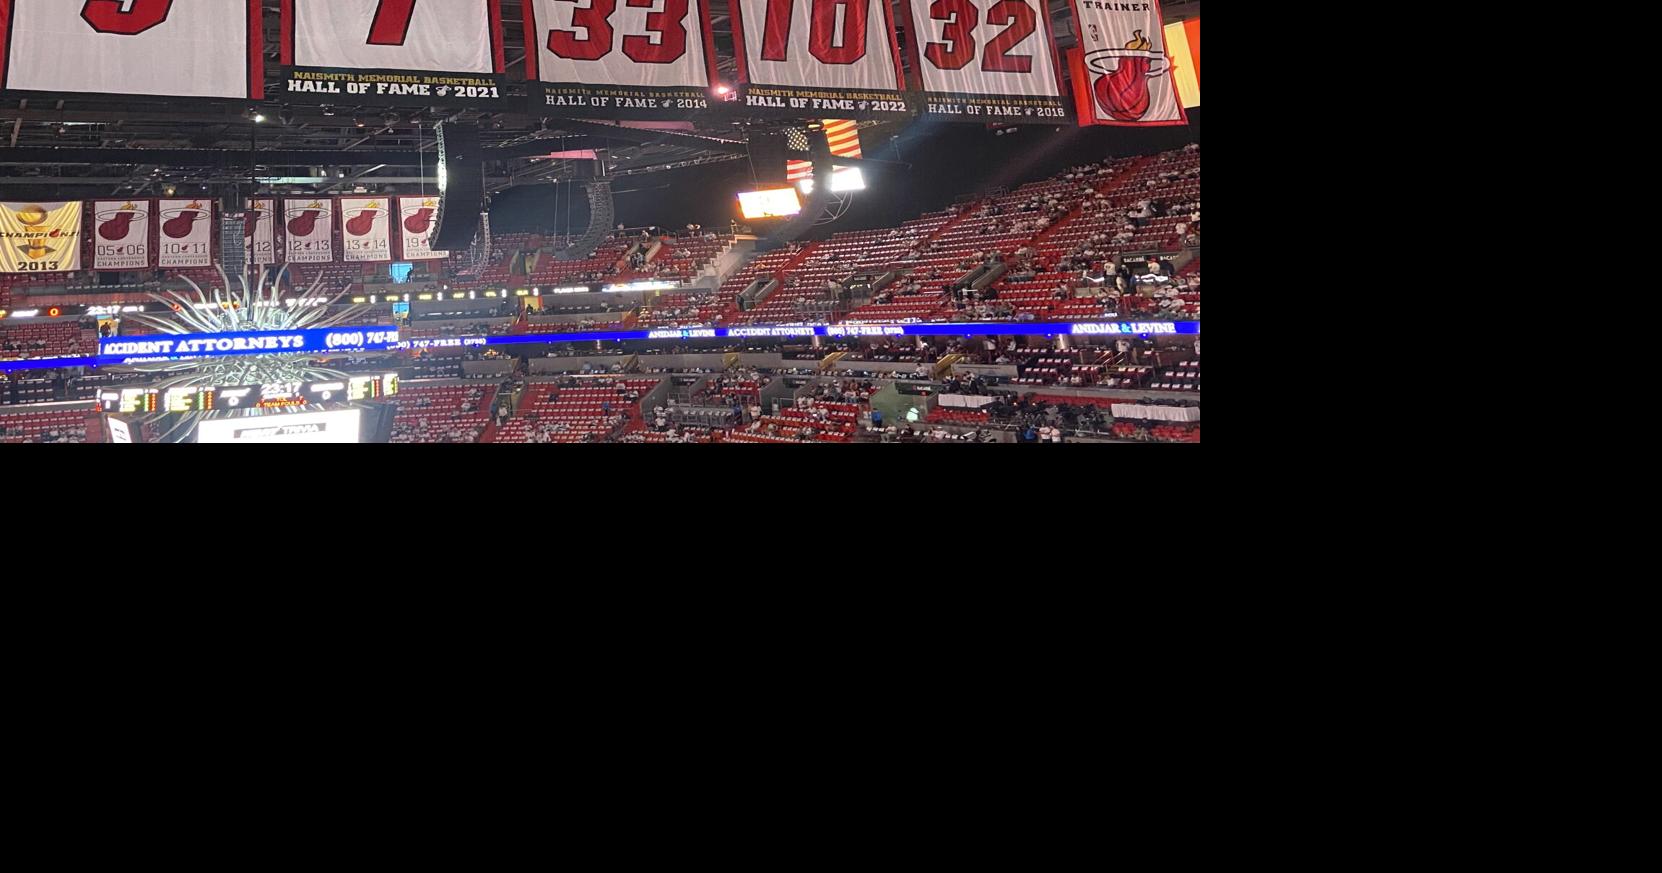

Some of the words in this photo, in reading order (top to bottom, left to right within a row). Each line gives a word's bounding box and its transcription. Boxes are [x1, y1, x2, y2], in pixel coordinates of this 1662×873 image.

[1083, 1, 1150, 11] TRAINER
[924, 0, 1036, 73] 32
[294, 72, 354, 81] NAISMITH
[358, 74, 420, 83] MEMORIAL
[424, 76, 496, 86] BASKETBALL
[288, 80, 340, 93] HALL
[347, 82, 370, 94] OF
[377, 83, 430, 96] FAME
[454, 86, 499, 98] 2021
[748, 88, 794, 97] NAISMITH
[796, 90, 845, 99] MEMORIAL
[846, 92, 902, 101] BASKETBALL
[545, 95, 586, 106] HALL
[591, 97, 609, 107] OF
[616, 98, 657, 108] FAME
[677, 99, 708, 109] 2014
[745, 95, 786, 107] HALL
[790, 98, 808, 109] OF
[812, 98, 854, 110] FAME
[872, 100, 907, 112] 2022
[928, 104, 961, 114] HALL
[966, 105, 981, 115] OF
[986, 106, 1021, 116] FAME
[1037, 107, 1065, 117] 2016
[98, 245, 114, 255] 05
[127, 245, 145, 255] 06
[164, 244, 180, 254] 10
[194, 243, 206, 254] 11
[288, 241, 302, 250] 12
[315, 240, 329, 250] 13
[346, 240, 360, 250] 13
[374, 239, 386, 249] 14
[18, 261, 59, 271] 2013
[728, 327, 770, 336] ACCIDENT
[771, 327, 815, 336] ATTORNEYS
[1072, 323, 1121, 333] ANIDJAR
[1121, 323, 1132, 333] &
[1132, 323, 1176, 333] LEVINE
[104, 341, 173, 355] ACCIDENT
[175, 335, 304, 352] ATTORNEYS
[326, 332, 363, 347] (800)
[413, 339, 461, 348] 747-FREE
[261, 382, 302, 394] 23:17
